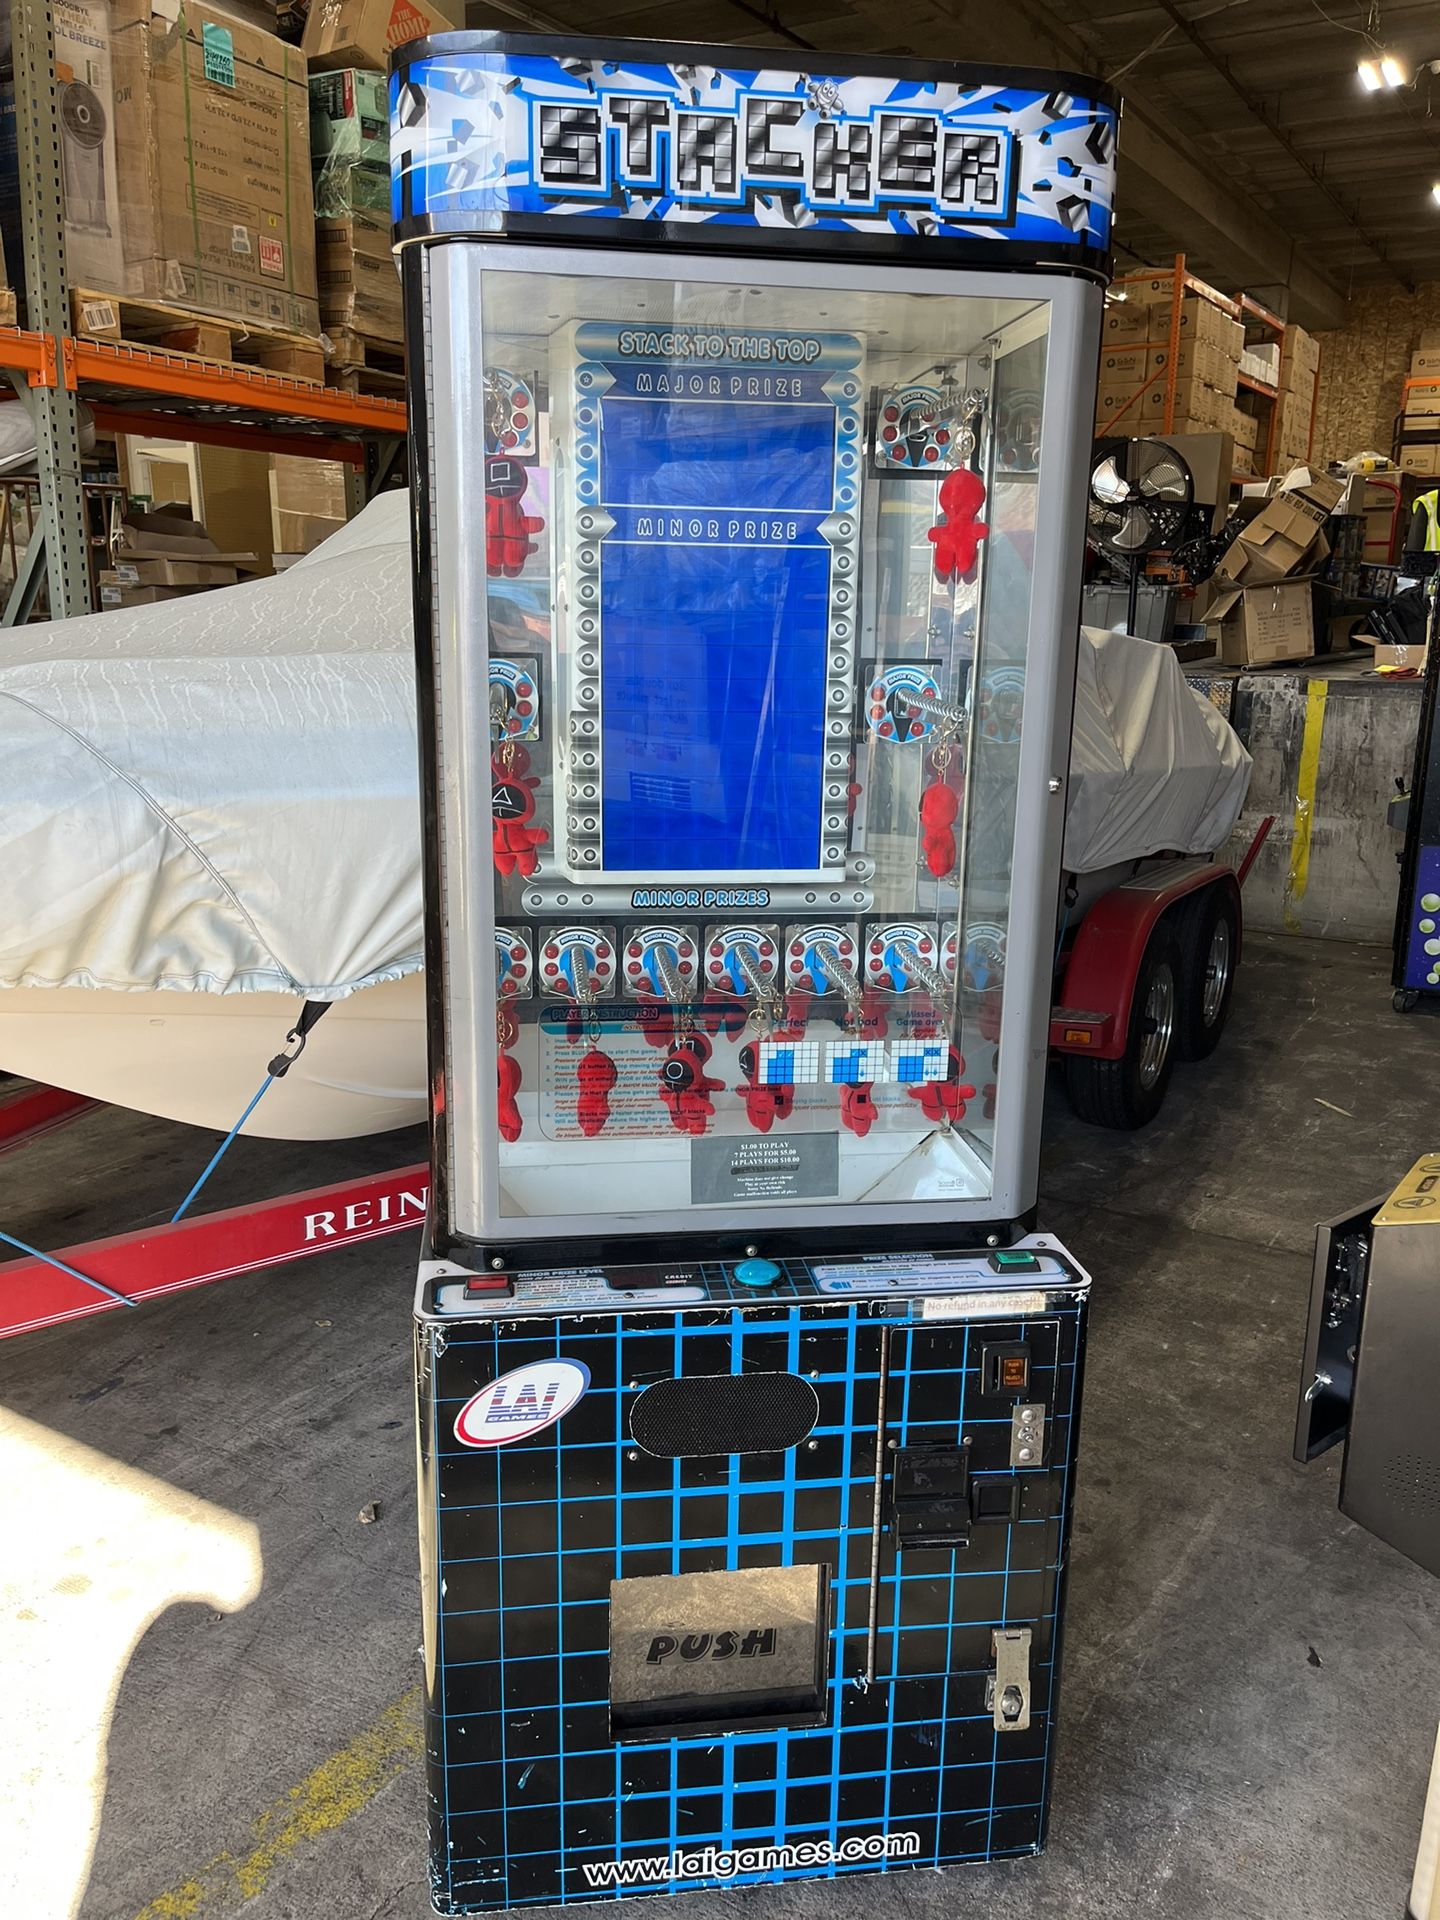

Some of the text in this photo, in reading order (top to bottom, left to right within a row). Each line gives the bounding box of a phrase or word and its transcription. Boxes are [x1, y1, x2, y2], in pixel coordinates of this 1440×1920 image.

[396, 8, 412, 20] THE
[388, 15, 428, 43] HOME
[69, 30, 106, 50] BREEZE
[537, 96, 1003, 207] STACKER
[620, 331, 822, 361] STACK TO THE TOP
[636, 373, 802, 397] MAJOR PRIZE
[637, 517, 798, 540] MINOR PRIZE
[632, 888, 771, 908] MINOR PRIZES
[552, 1007, 589, 1020] PLAYER
[835, 1017, 879, 1027] Not bad
[896, 1018, 923, 1027] Game
[905, 1009, 936, 1018] Missed
[770, 1141, 790, 1149] PLAY
[303, 1186, 429, 1241] REIN
[888, 1253, 934, 1261] SELECTION
[517, 1271, 550, 1279] MINOR
[927, 1301, 941, 1312] No
[943, 1299, 976, 1311] refund
[977, 1300, 987, 1309] in
[988, 1299, 1007, 1309] any
[487, 1382, 561, 1414] LAI
[486, 1412, 549, 1423] GAMES
[645, 1627, 777, 1666] PUSH
[582, 1830, 921, 1888] www.laigames.com
